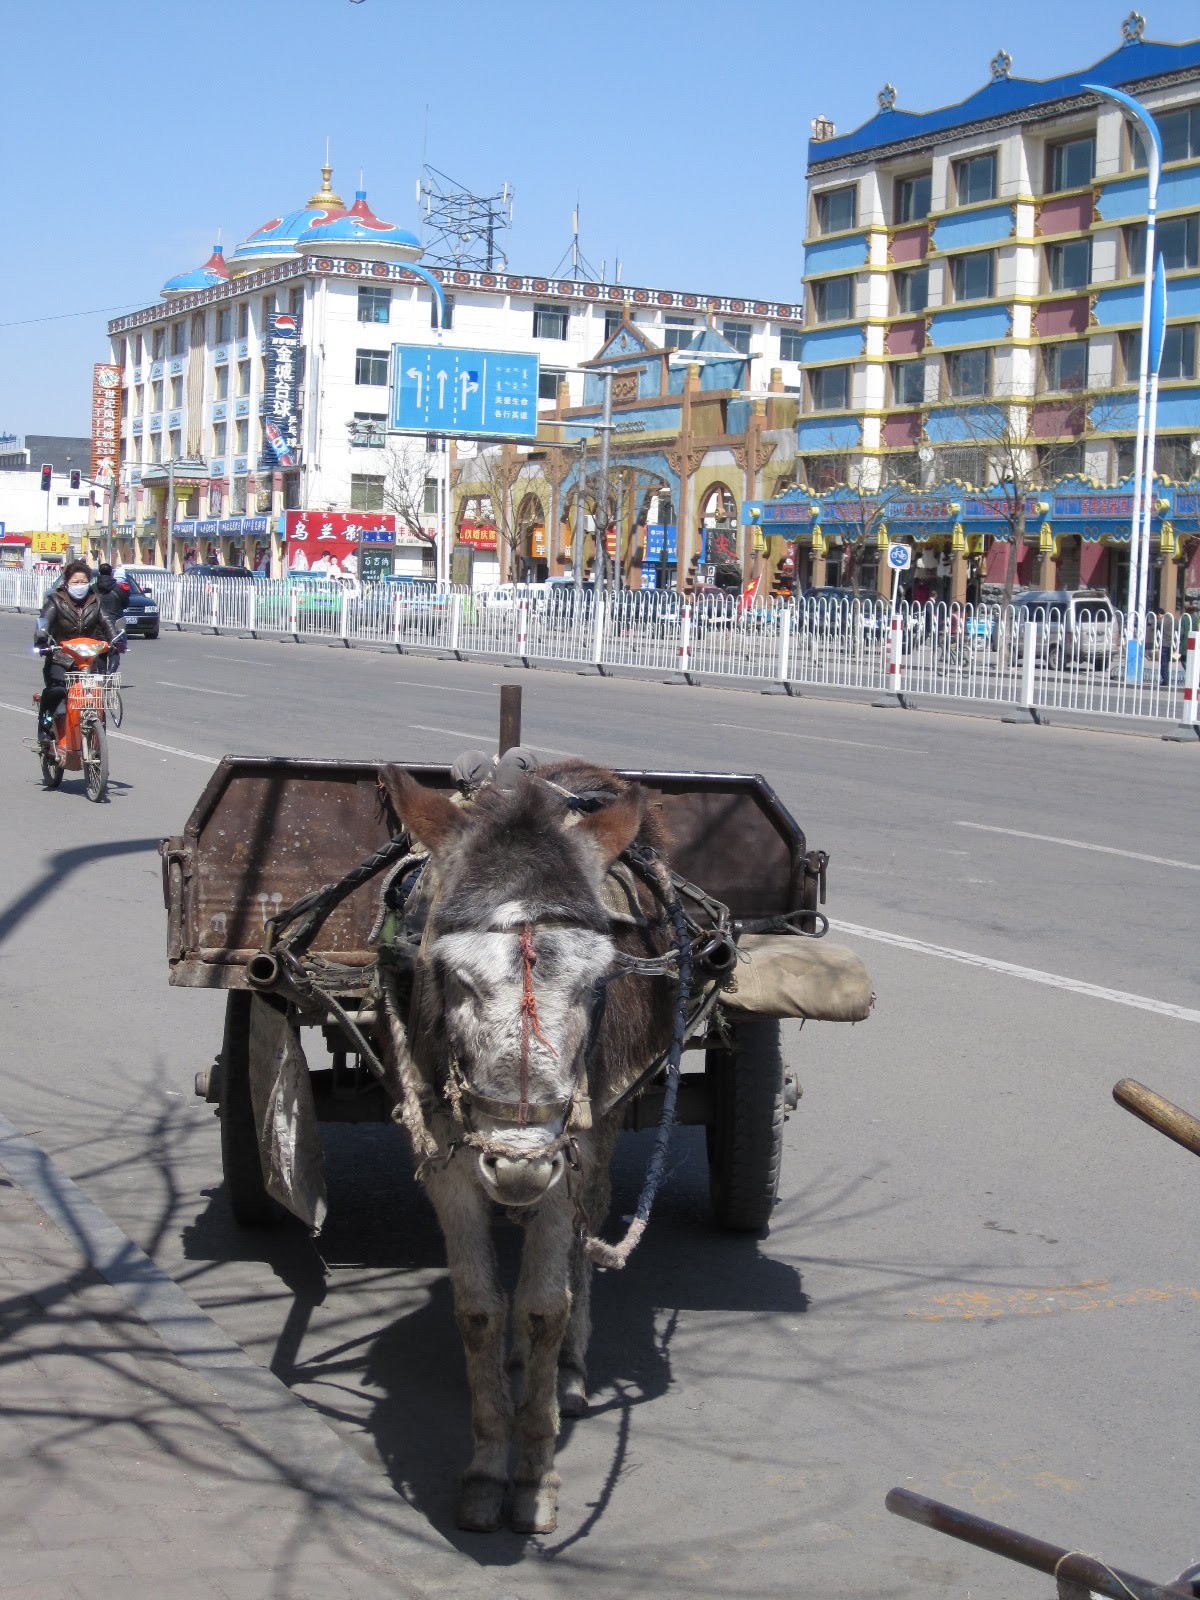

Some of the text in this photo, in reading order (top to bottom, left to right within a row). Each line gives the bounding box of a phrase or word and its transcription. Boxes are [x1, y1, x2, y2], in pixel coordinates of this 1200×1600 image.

[272, 345, 293, 417] 金城台球
[495, 395, 529, 406] 关爱生命
[495, 409, 528, 420] 各行其道
